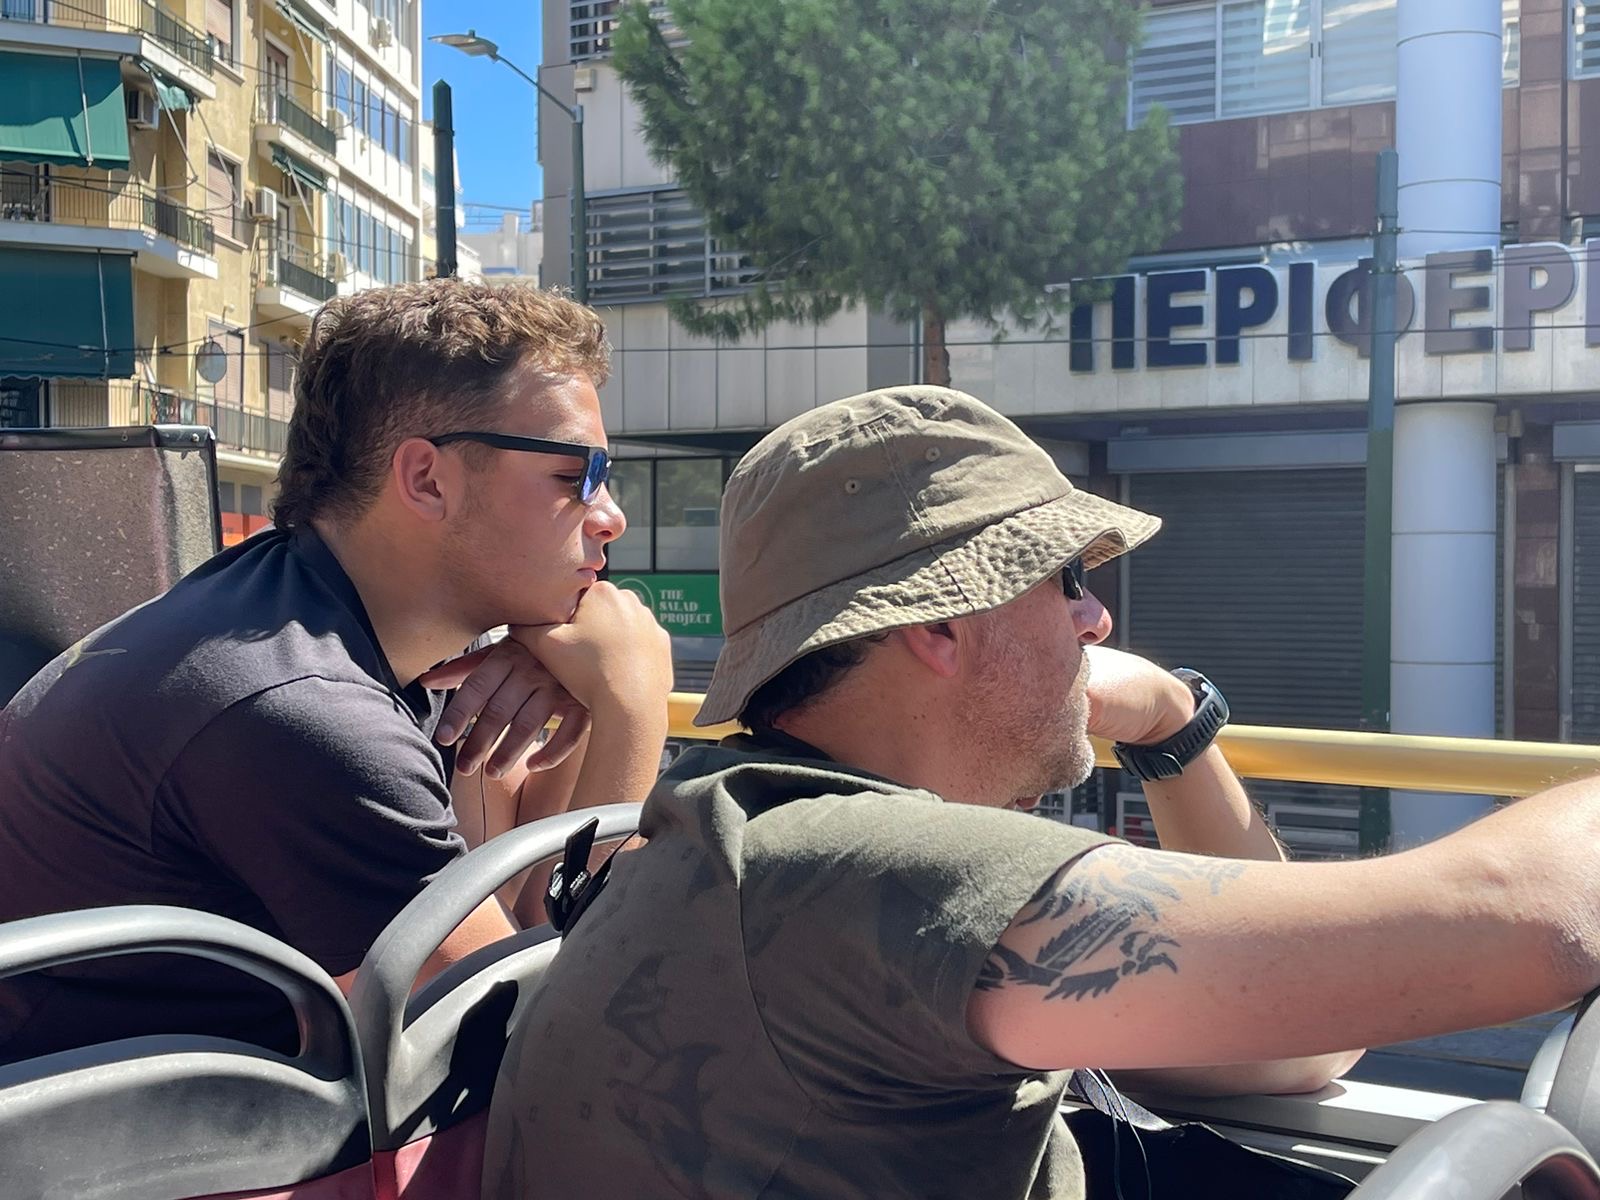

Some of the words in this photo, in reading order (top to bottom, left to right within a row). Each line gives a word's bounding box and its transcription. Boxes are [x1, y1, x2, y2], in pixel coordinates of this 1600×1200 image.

[1069, 239, 1600, 372] ΠΕΡΙΦΕΡ
[659, 589, 684, 600] THE
[659, 601, 698, 612] SALAD
[659, 613, 712, 625] PROJECT
